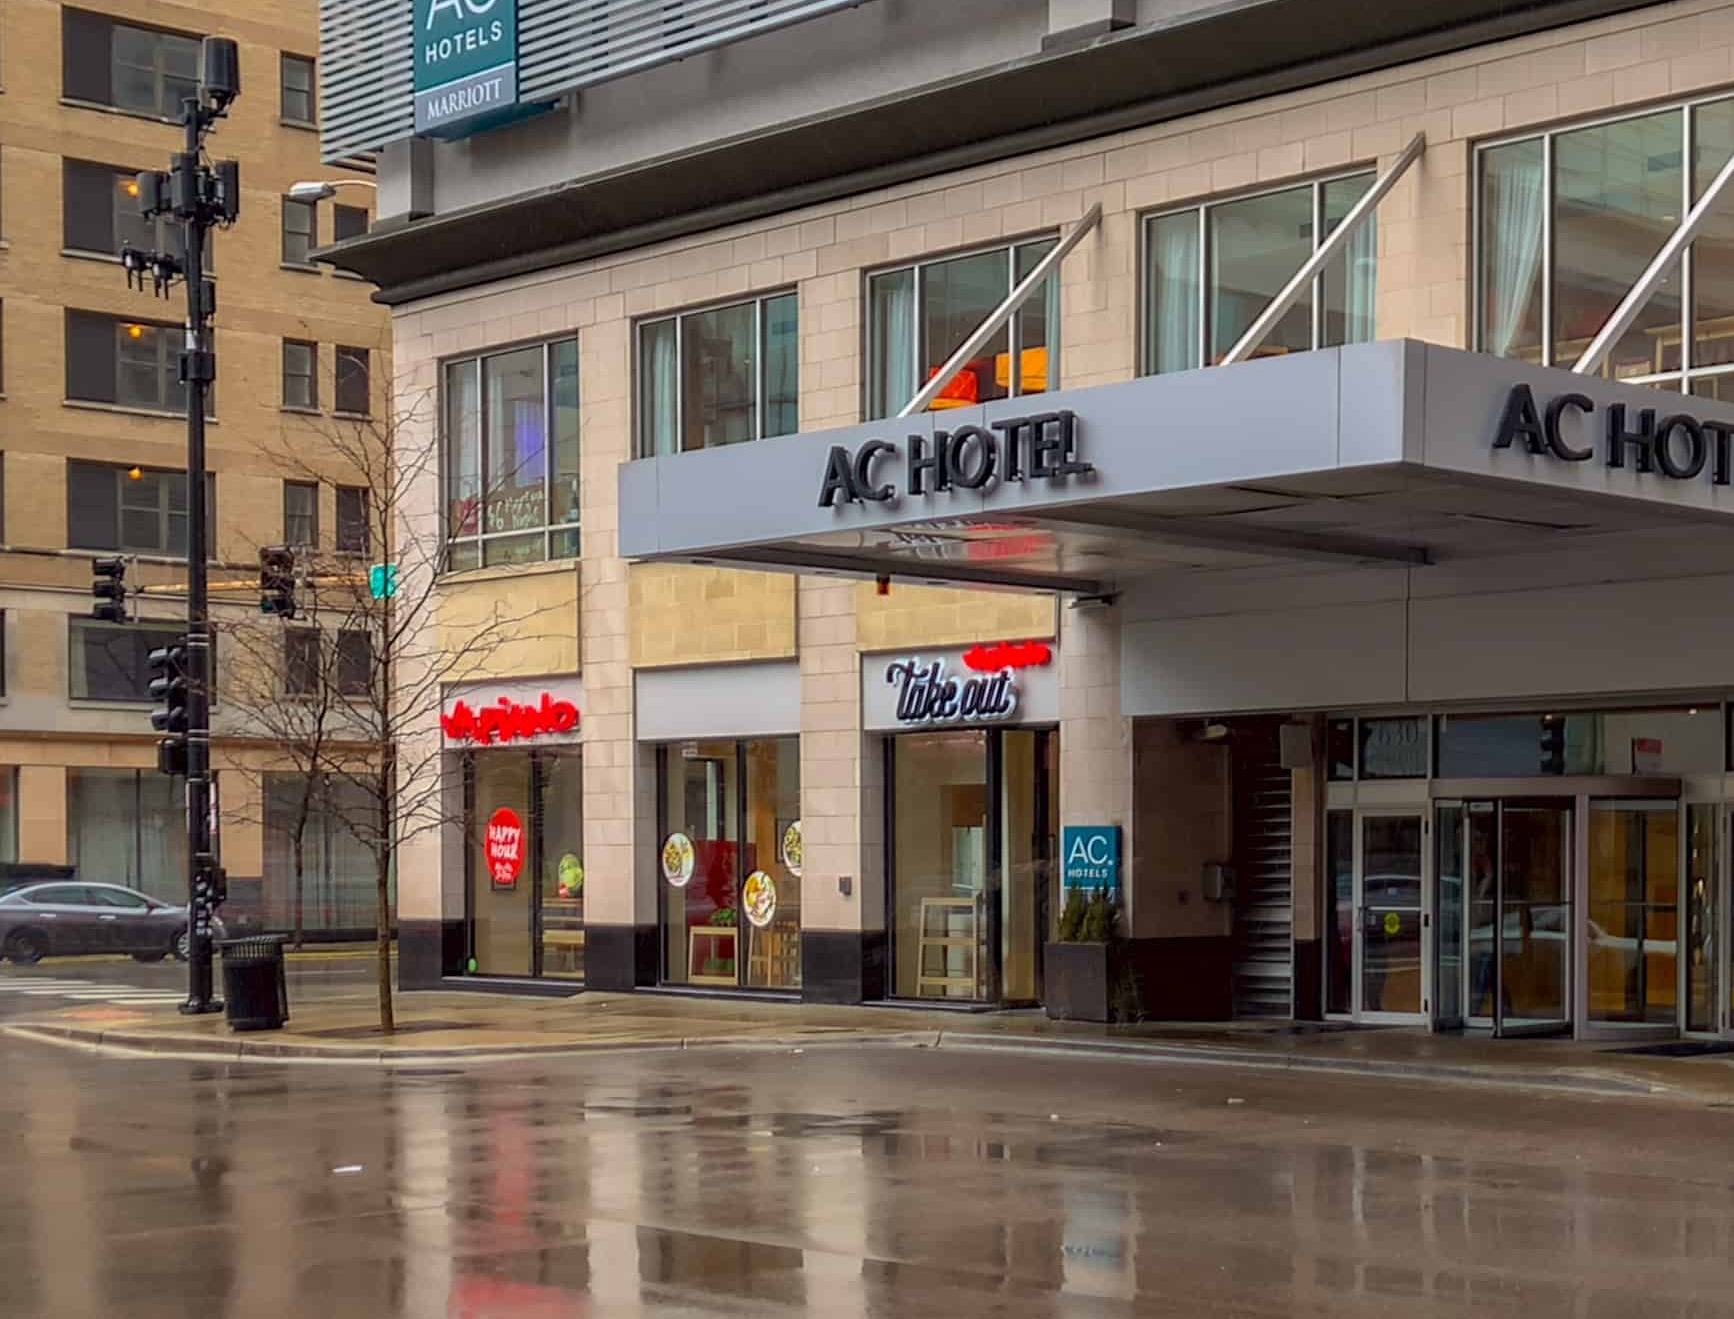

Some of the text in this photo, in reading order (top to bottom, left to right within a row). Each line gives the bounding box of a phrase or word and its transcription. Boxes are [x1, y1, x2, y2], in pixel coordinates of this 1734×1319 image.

[425, 20, 502, 64] HOTELS
[427, 78, 502, 120] MARRIOTT
[1493, 383, 1594, 461] AC
[818, 410, 1093, 507] AC HOTEL
[489, 825, 520, 843] HAPPY
[490, 842, 518, 860] HOUR
[1067, 868, 1108, 878] HOTELS
